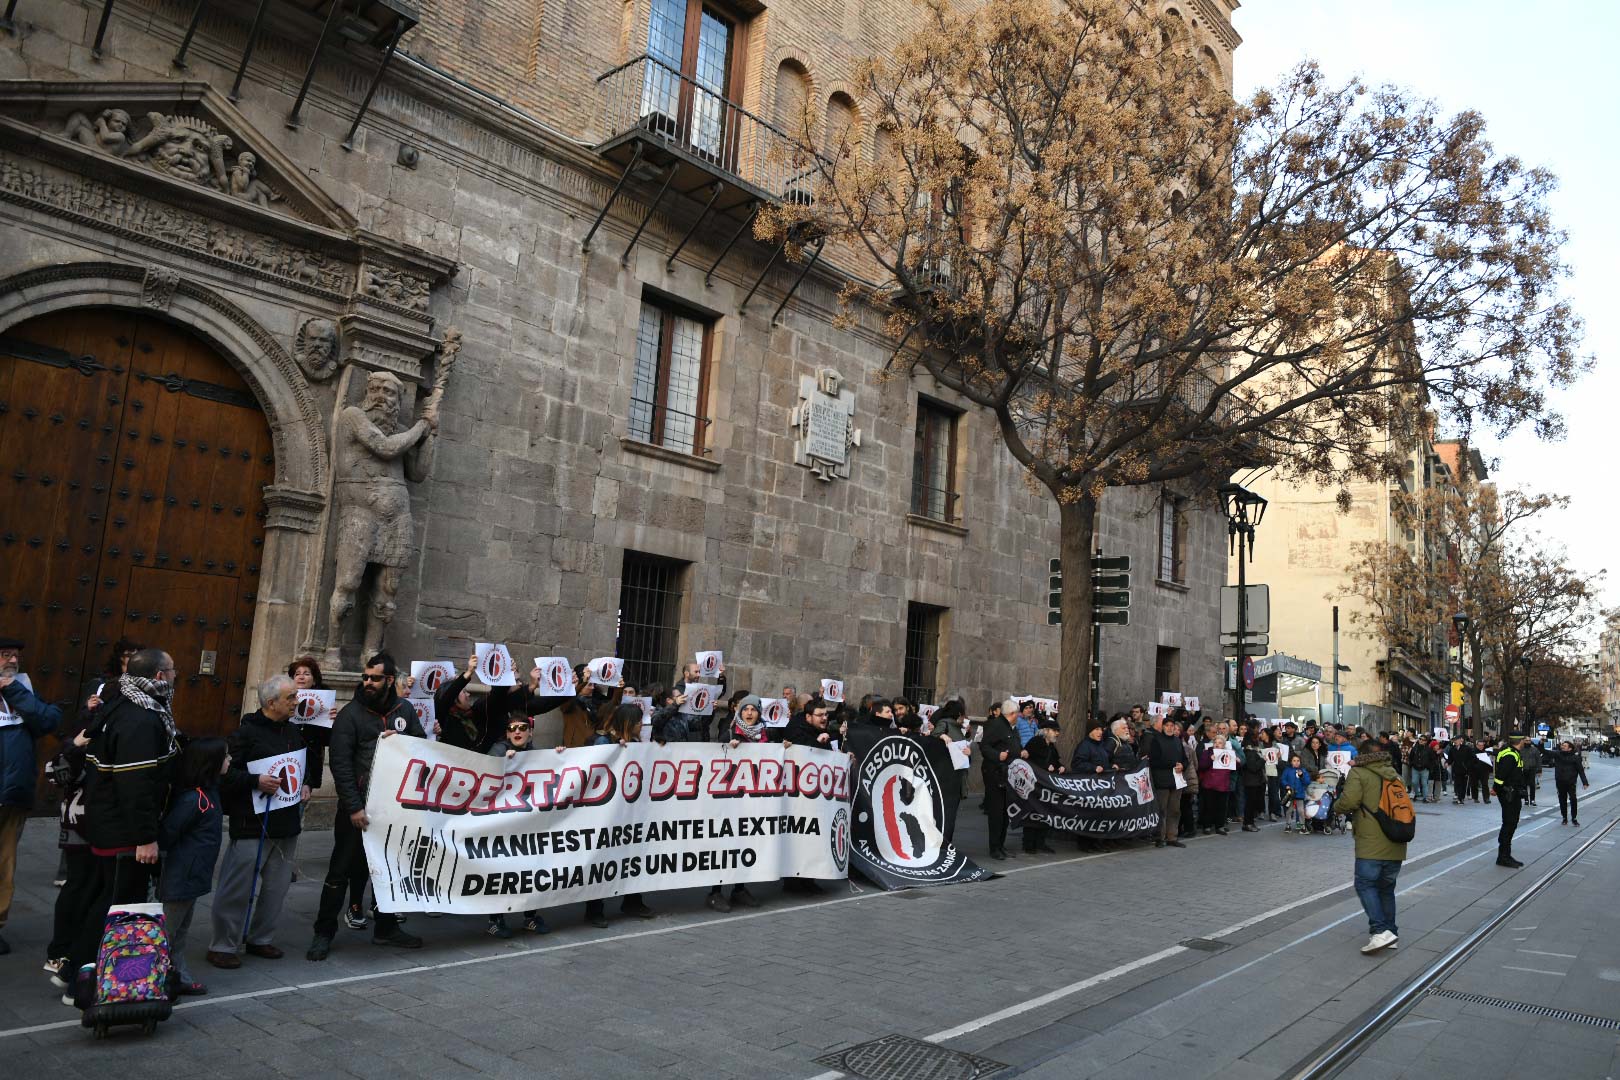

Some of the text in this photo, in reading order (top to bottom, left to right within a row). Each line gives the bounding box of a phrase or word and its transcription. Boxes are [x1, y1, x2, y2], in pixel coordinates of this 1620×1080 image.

[396, 759, 616, 816] LIBERTAD
[621, 760, 644, 803] 6
[649, 759, 702, 800] DE
[1049, 774, 1110, 791] LIBERTAD
[1040, 789, 1132, 808] DE ZARAGOZA
[465, 822, 643, 859] MANIFESTARSE
[645, 819, 704, 842] ANTE
[708, 818, 734, 838] LA
[1089, 820, 1117, 832] LEY
[461, 848, 757, 897] DERECHA NO ES UN DELITO
